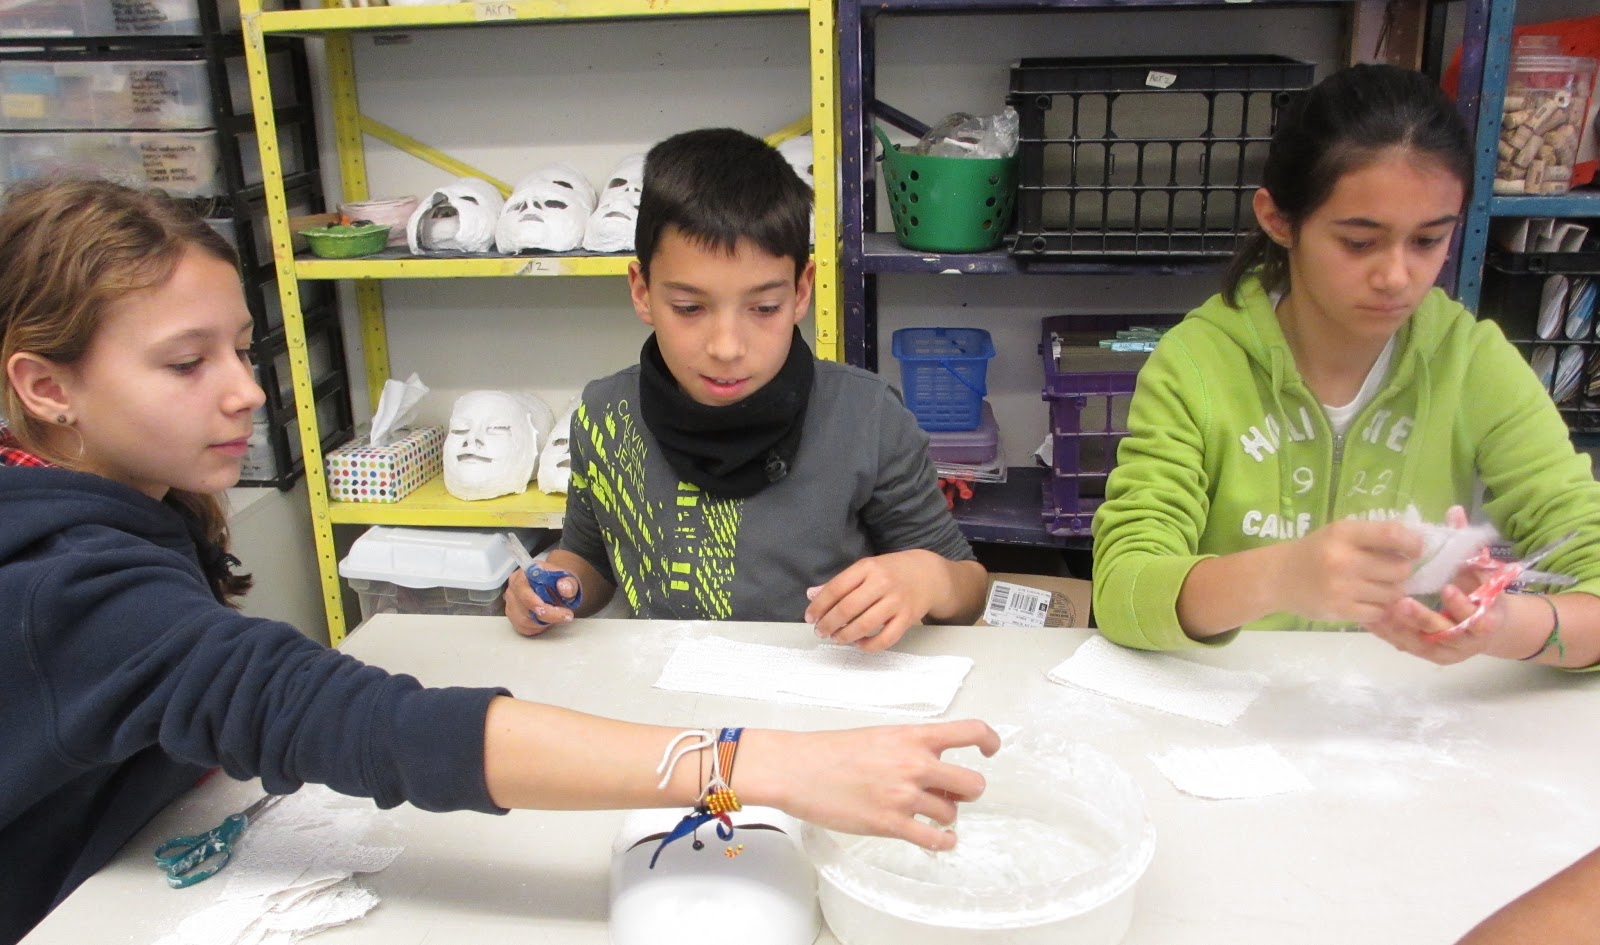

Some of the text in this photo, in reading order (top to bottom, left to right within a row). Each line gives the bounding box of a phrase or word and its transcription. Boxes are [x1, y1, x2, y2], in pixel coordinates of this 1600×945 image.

[618, 399, 648, 460] CALVIN
[622, 430, 646, 482] KLEIN
[614, 443, 645, 503] JEANS
